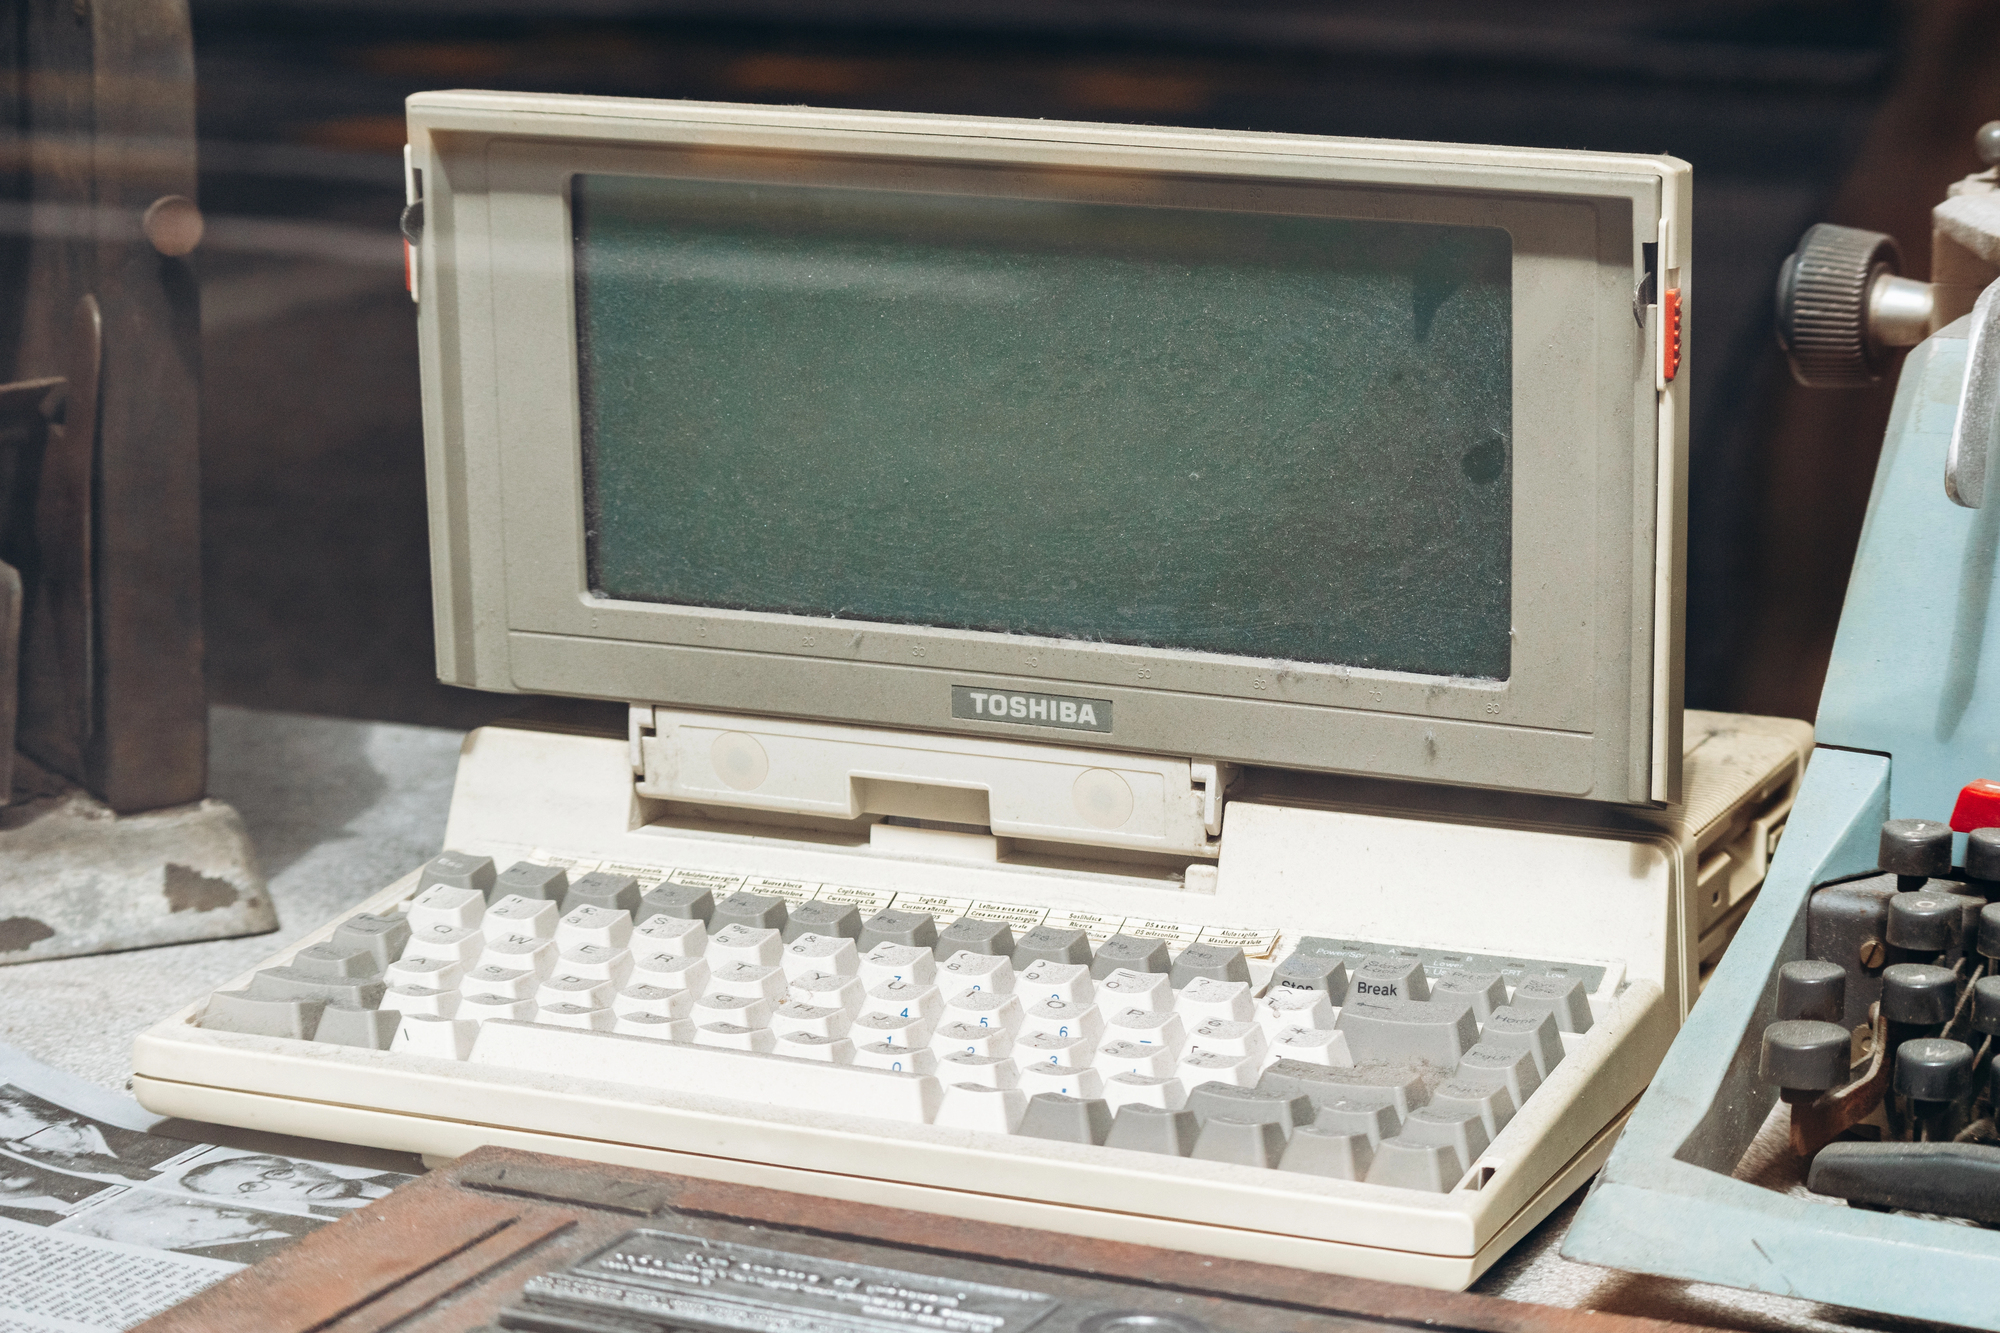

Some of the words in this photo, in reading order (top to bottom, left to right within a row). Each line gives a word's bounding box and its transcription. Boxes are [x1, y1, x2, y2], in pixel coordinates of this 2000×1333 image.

[801, 636, 816, 648] 20
[1024, 656, 1039, 668] 40
[1137, 668, 1152, 680] 50
[970, 692, 1097, 726] TOSHIBA
[1486, 702, 1500, 715] 80
[433, 924, 453, 934] Q
[508, 934, 533, 945] W
[716, 935, 730, 943] 5
[580, 944, 600, 954] E
[410, 957, 426, 965] A
[654, 953, 674, 963] R
[736, 962, 752, 971] T
[947, 963, 962, 971] 8
[1433, 960, 1464, 968] Lower
[485, 965, 503, 974] S
[561, 975, 580, 983] D
[814, 972, 830, 981] Y
[1025, 972, 1040, 980] 9
[1545, 971, 1566, 979] Low
[887, 981, 907, 990] U
[1357, 981, 1398, 997] Break
[900, 1007, 909, 1018] 4
[1126, 1008, 1145, 1018] P
[980, 1017, 989, 1028] 5
[1059, 1025, 1068, 1037] 6
[886, 1035, 892, 1044] 1
[892, 1061, 902, 1072] 0
